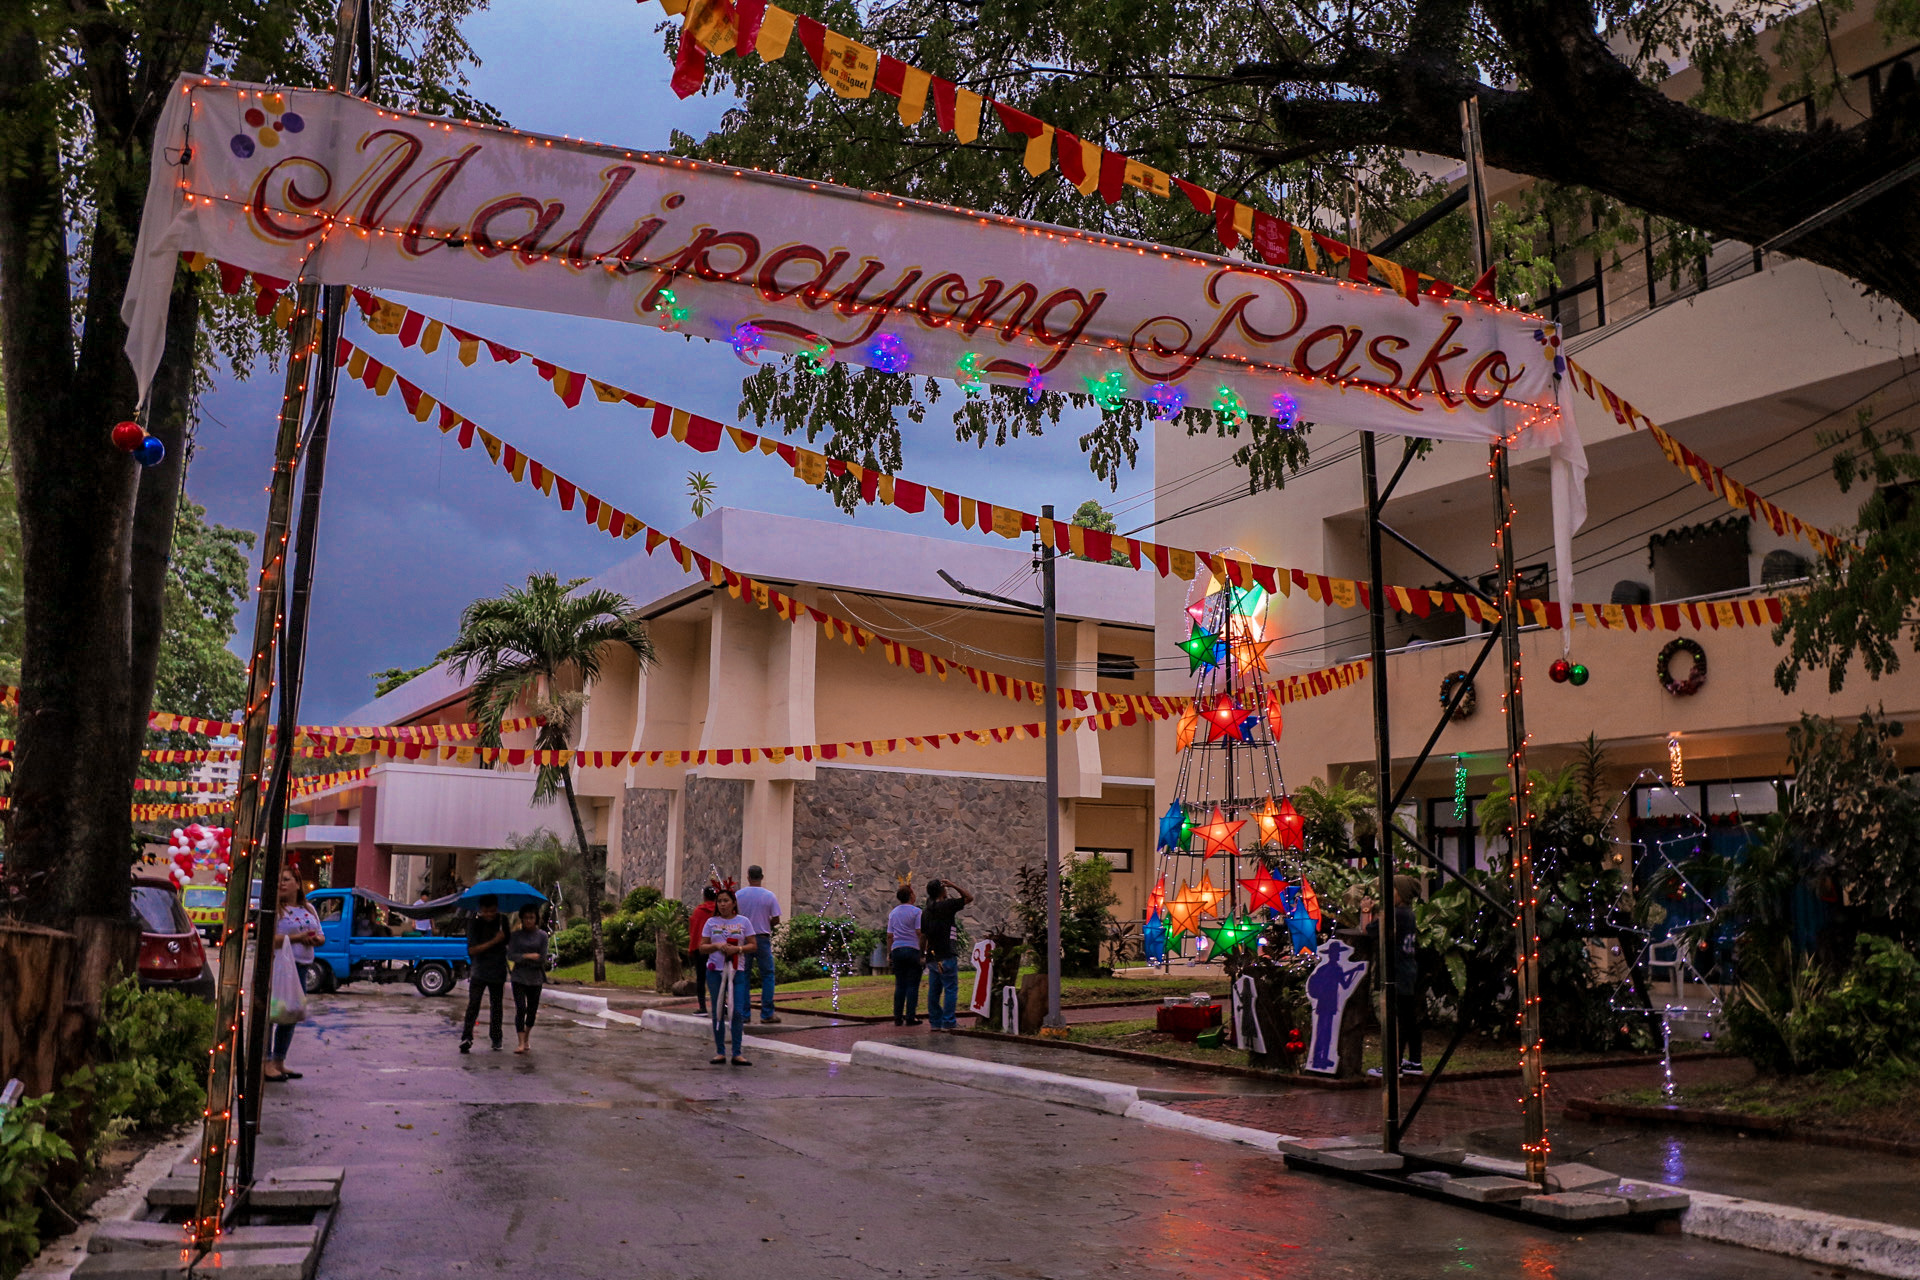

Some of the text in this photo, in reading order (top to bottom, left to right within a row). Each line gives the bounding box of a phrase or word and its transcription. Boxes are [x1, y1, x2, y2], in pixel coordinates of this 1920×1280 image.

[839, 68, 868, 90] Miguel
[248, 128, 1525, 413] Malipayong Pasko
